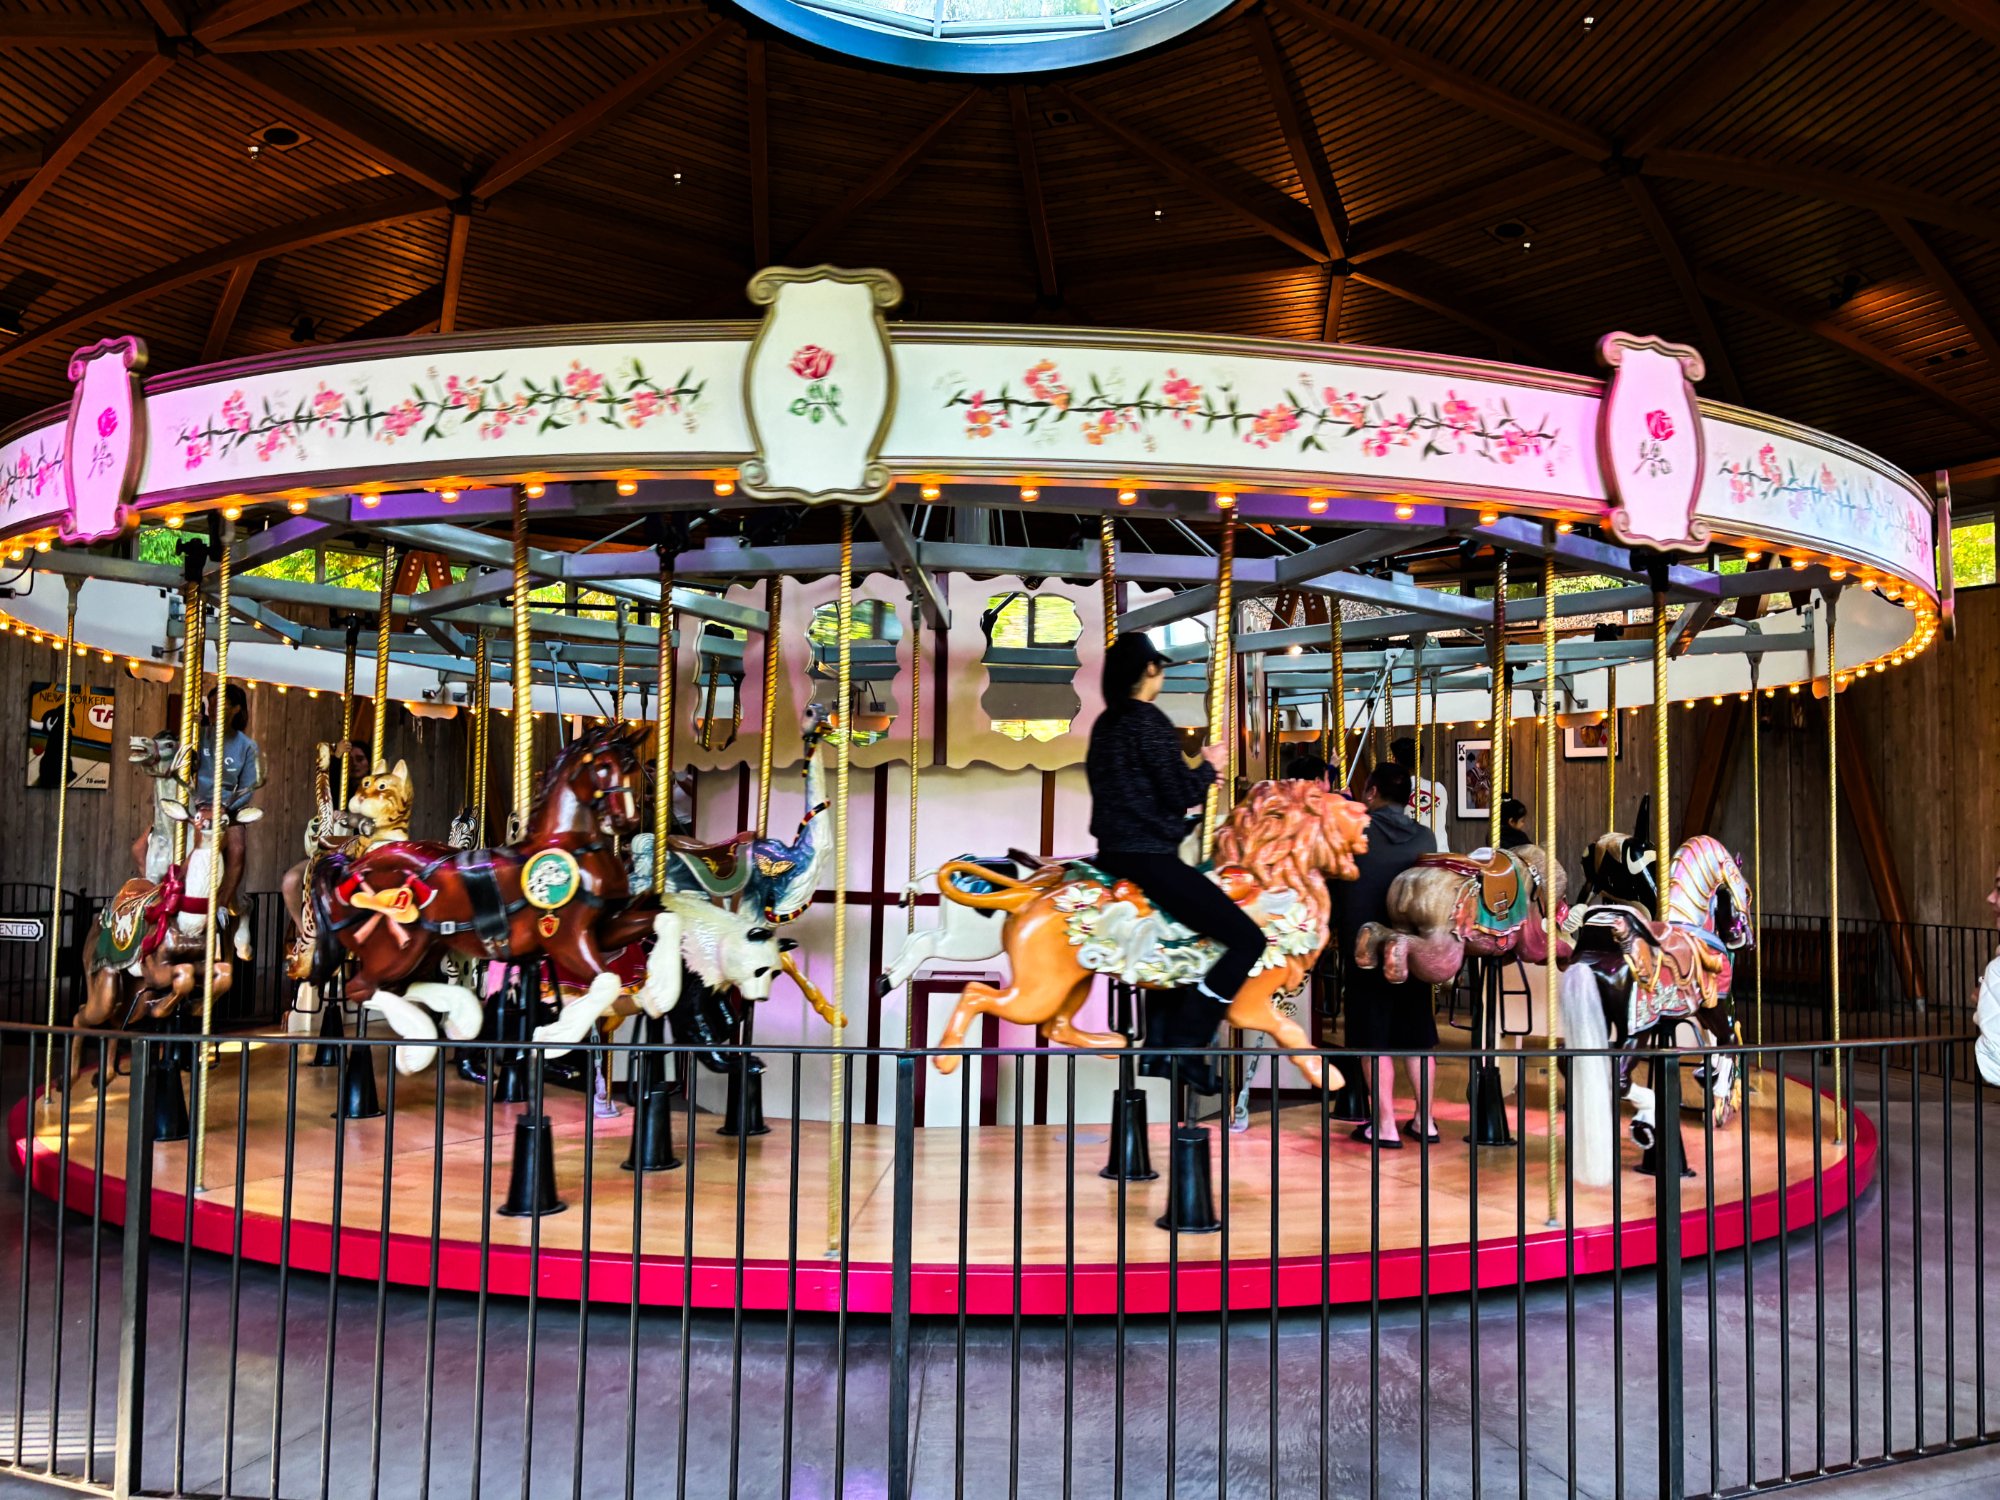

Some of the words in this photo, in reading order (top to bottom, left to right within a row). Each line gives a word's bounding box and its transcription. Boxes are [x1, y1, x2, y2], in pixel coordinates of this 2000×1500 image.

[40, 692, 64, 703] NEW
[1458, 744, 1465, 754] K
[0, 923, 35, 935] ENTER
